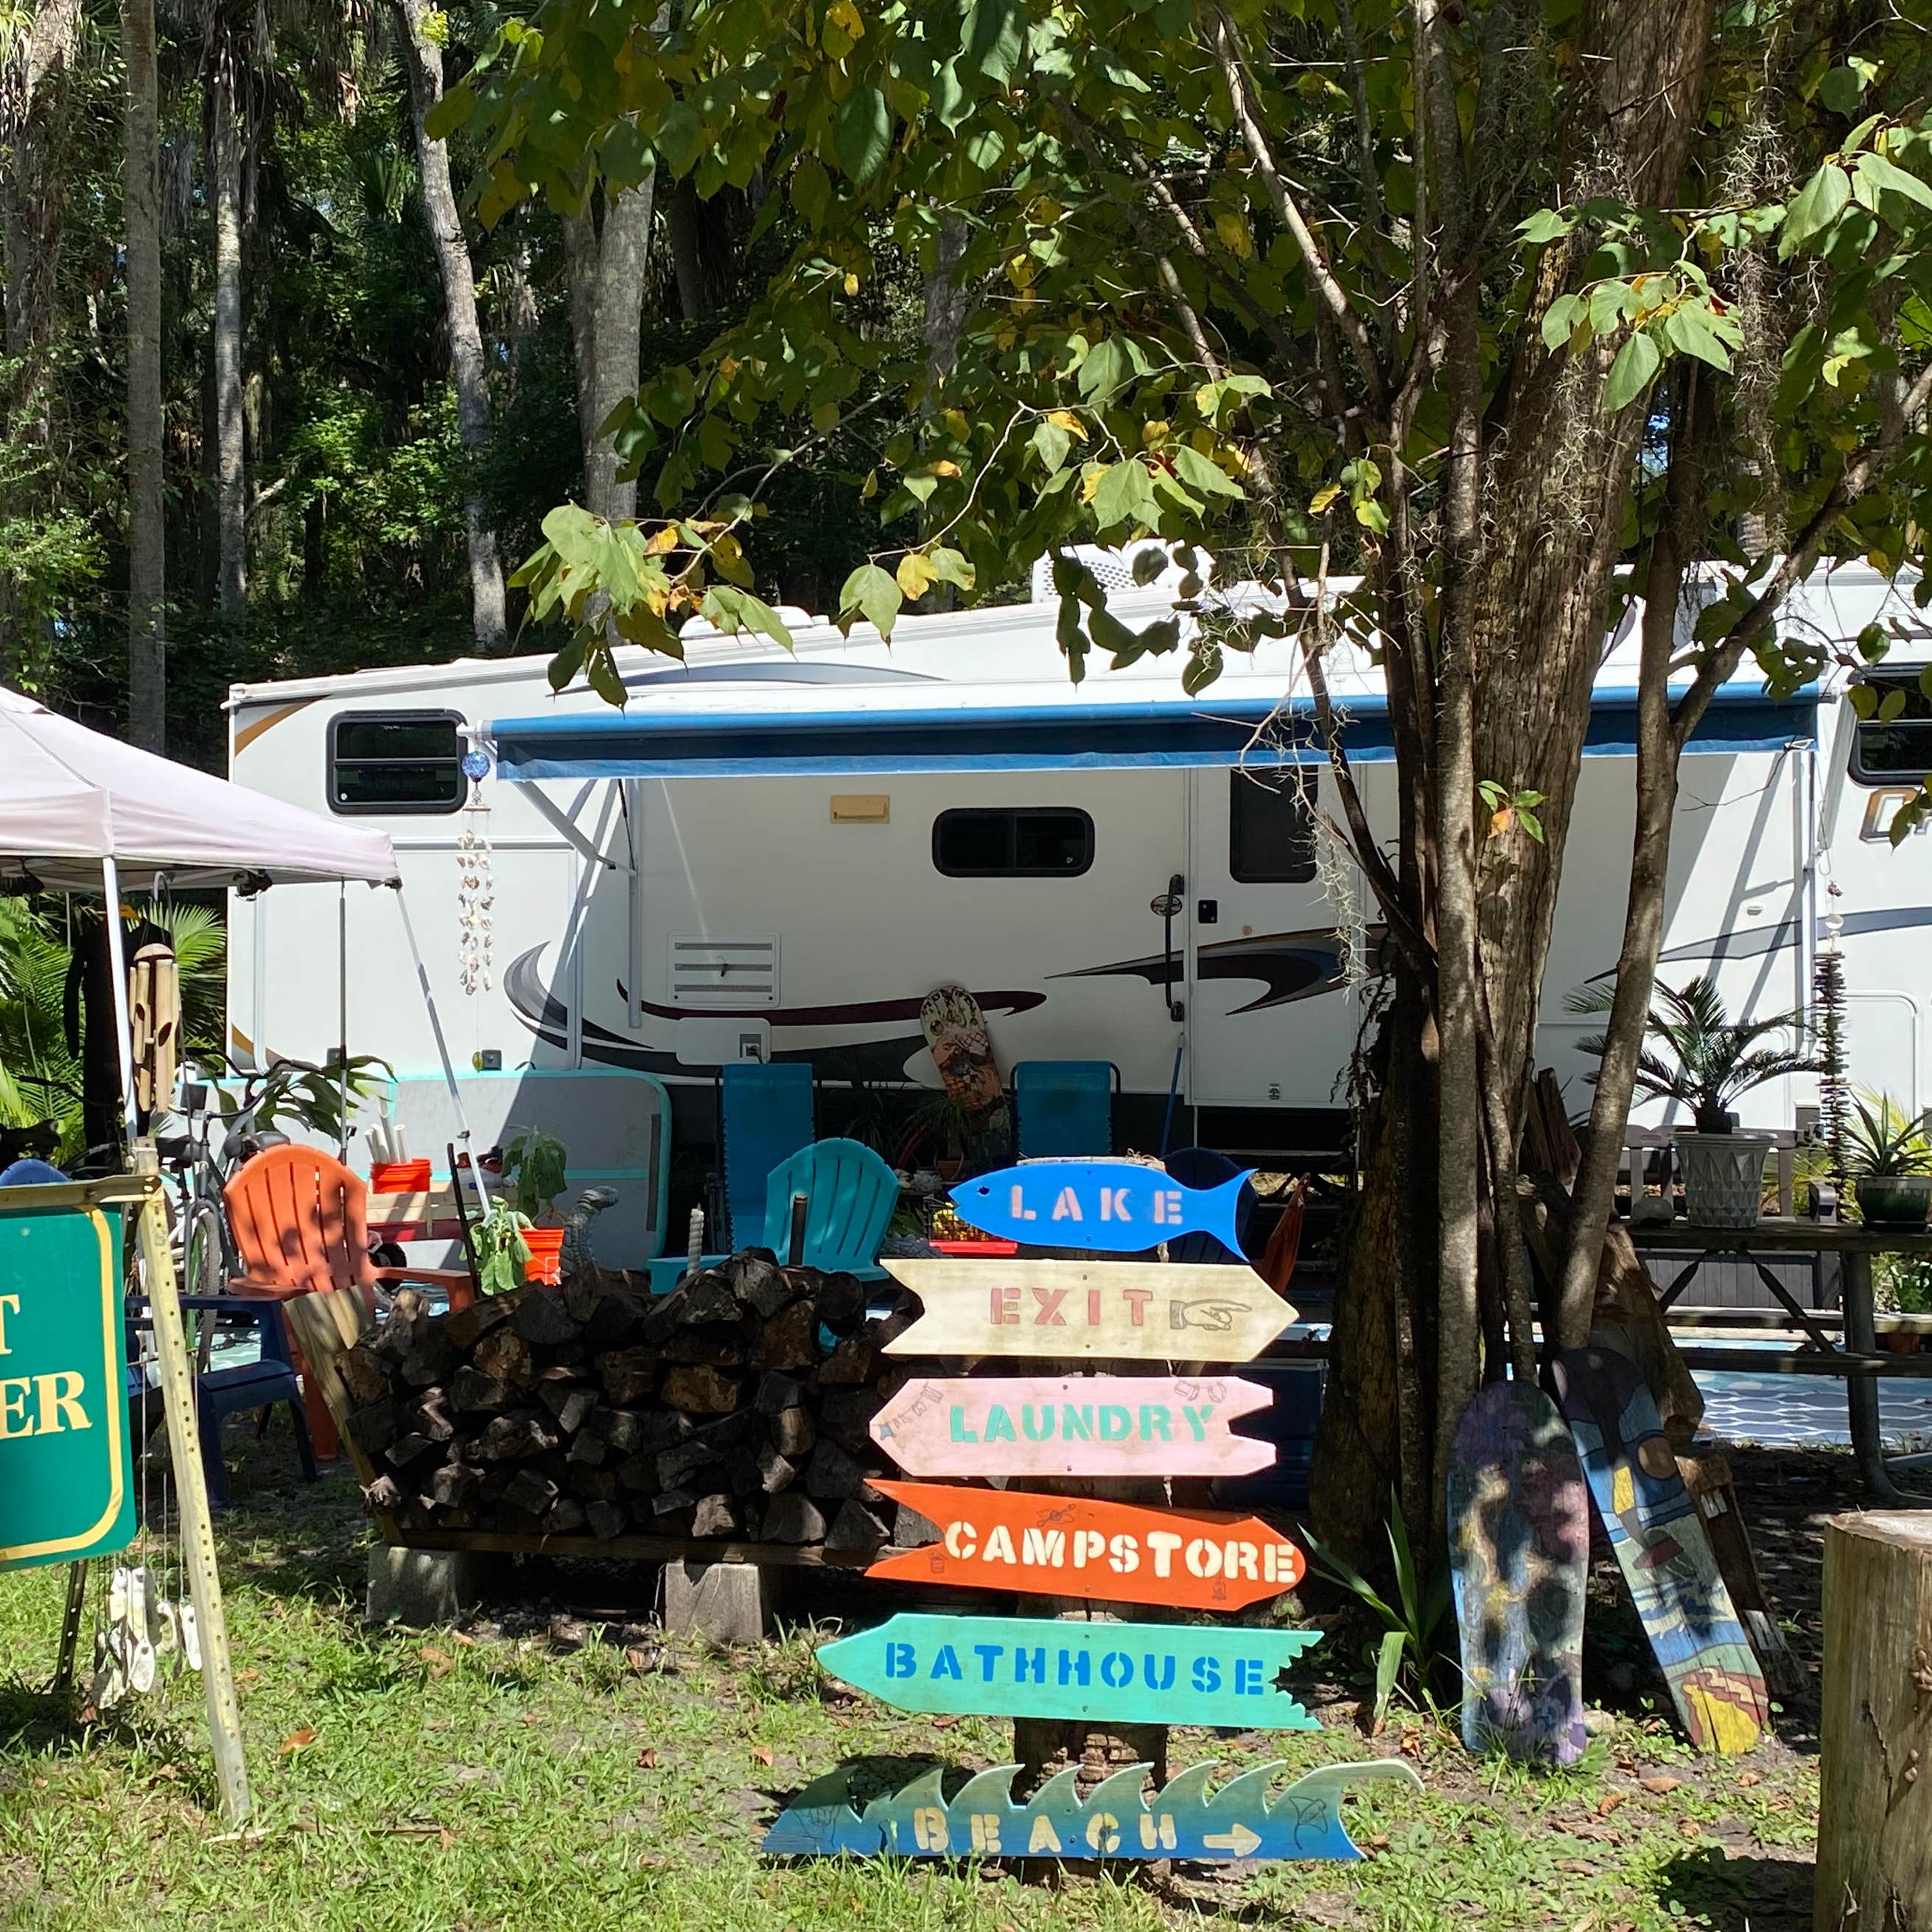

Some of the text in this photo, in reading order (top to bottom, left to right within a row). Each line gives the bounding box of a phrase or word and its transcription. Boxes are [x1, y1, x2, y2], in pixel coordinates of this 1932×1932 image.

[1012, 1186, 1182, 1224] LAKE
[991, 1287, 1153, 1326] EXIT
[950, 1404, 1214, 1444] LAUNDRY
[945, 1521, 1296, 1583] CAMPSTORE
[886, 1642, 1264, 1695] BATHHOUSE
[913, 1807, 1177, 1854] BEACH
